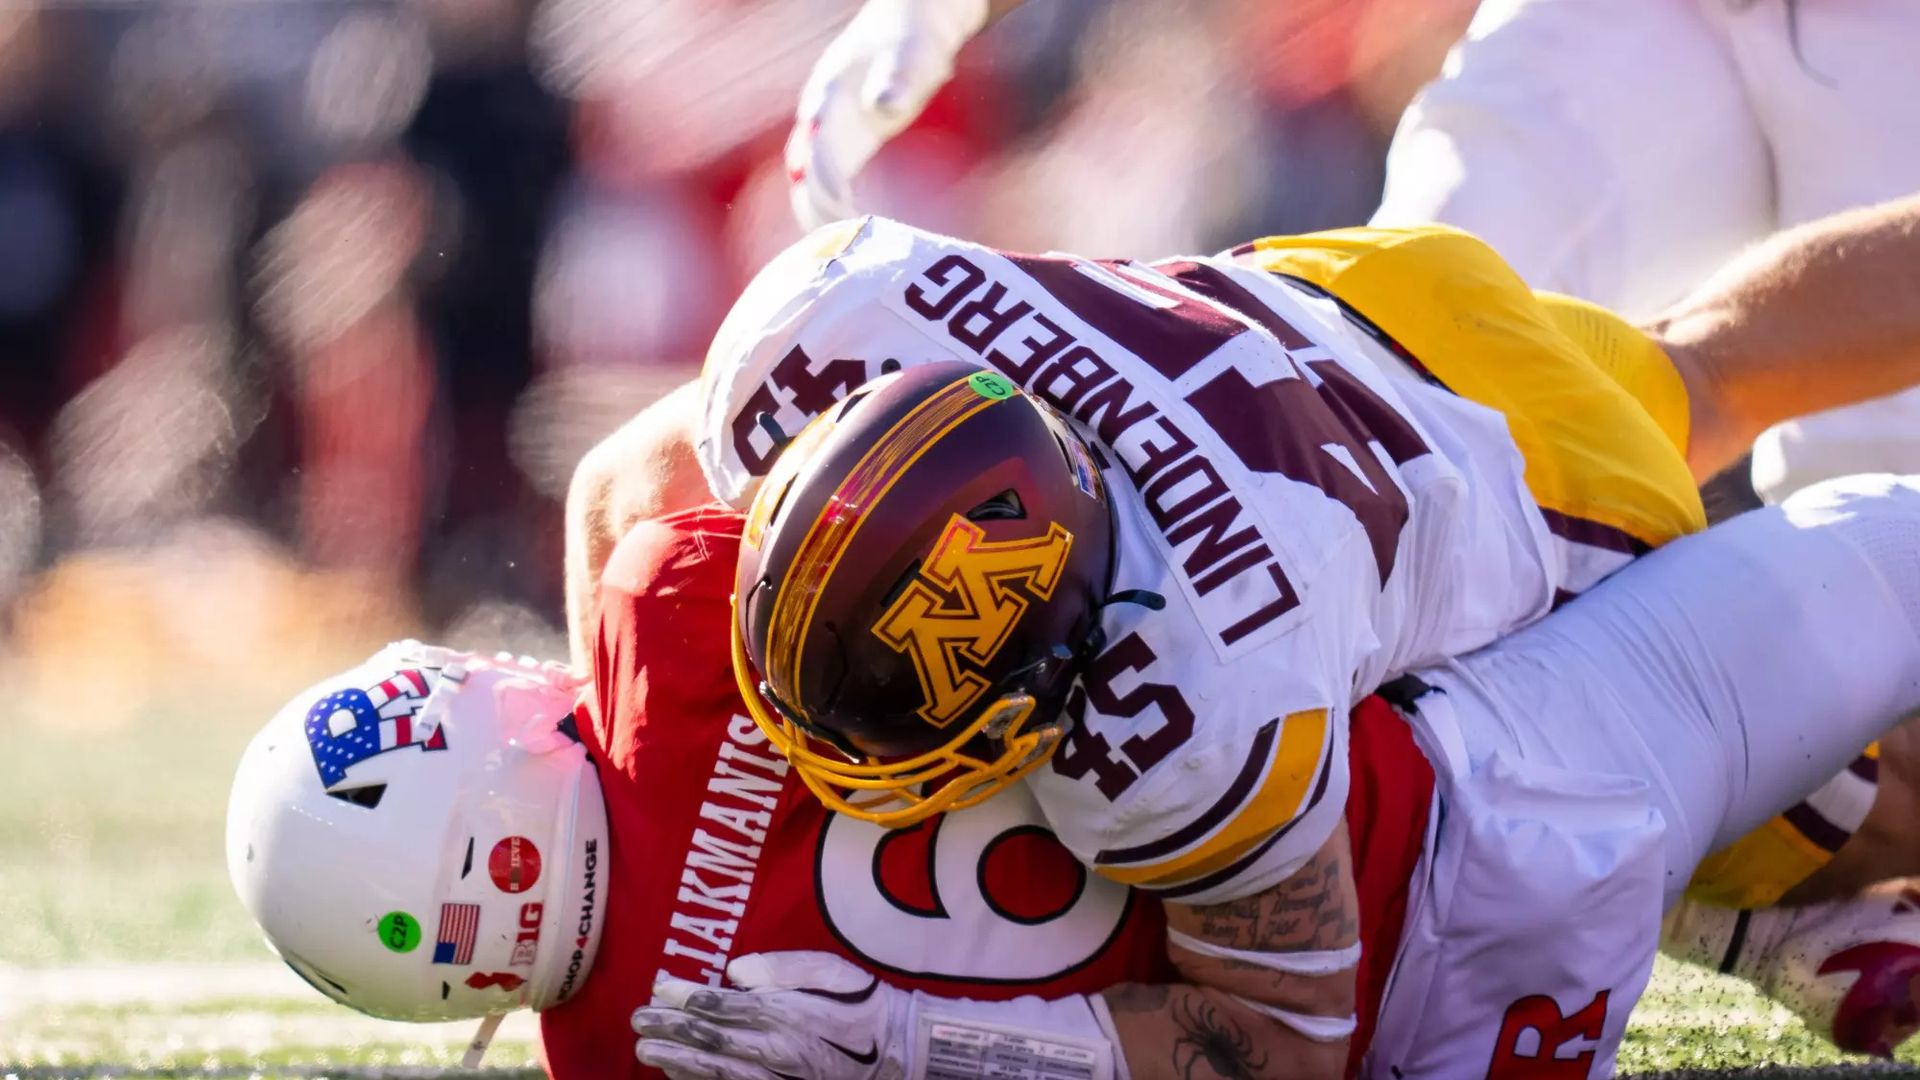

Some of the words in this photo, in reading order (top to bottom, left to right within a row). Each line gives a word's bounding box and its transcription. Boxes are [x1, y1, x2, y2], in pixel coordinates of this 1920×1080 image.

[732, 343, 867, 477] 45
[904, 254, 1302, 647] LINDENBERG
[975, 374, 1007, 397] C2P
[872, 512, 1074, 730] M
[304, 668, 448, 790] R
[1051, 631, 1196, 804] 45
[510, 837, 521, 892] BIEVE
[651, 713, 790, 1006] LIAKMANIS
[814, 781, 1135, 985] 6
[388, 913, 410, 951] C2P
[1485, 988, 1611, 1080] R
